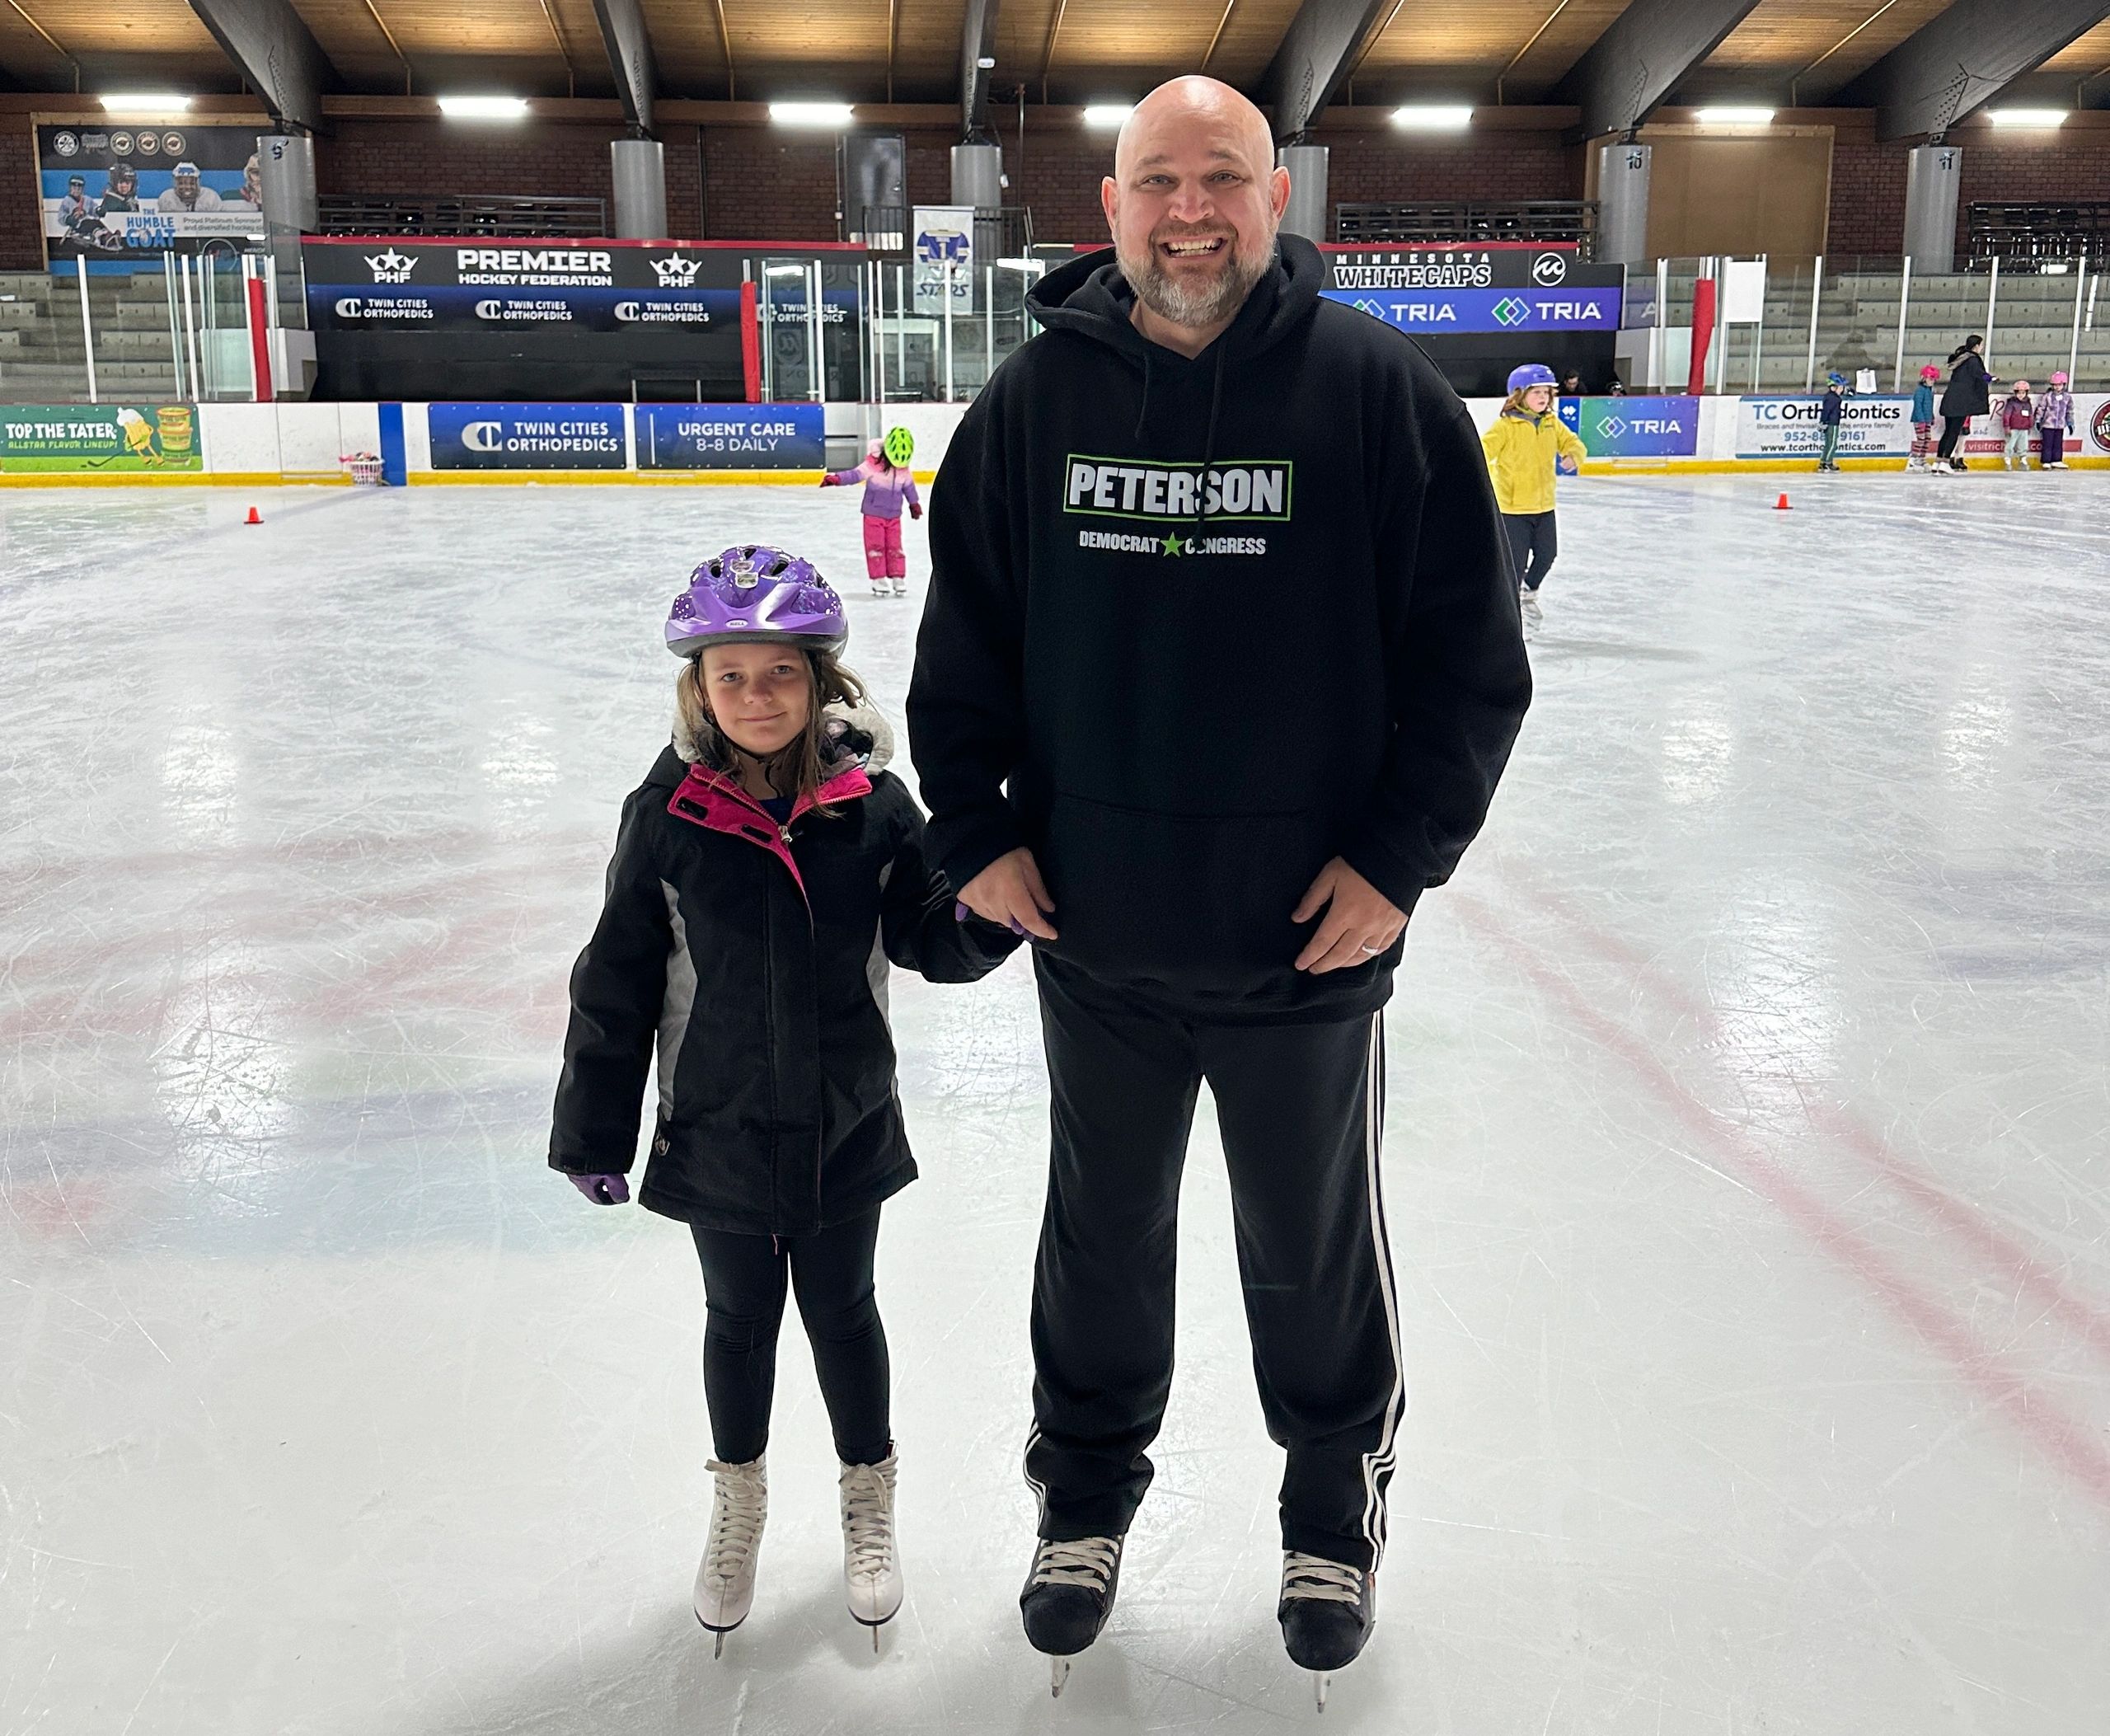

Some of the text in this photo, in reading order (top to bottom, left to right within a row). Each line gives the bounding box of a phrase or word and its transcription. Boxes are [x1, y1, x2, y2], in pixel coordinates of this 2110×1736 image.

[127, 217, 175, 228] HUMBLE
[126, 228, 176, 248] GOAT
[457, 249, 612, 273] PREMIER
[1336, 252, 1490, 265] MINNESOTA
[373, 271, 411, 284] PHF
[458, 273, 613, 286] HOCKEY FEDERATION
[659, 275, 694, 288] PHF
[1334, 264, 1492, 289] WHITECAPS
[368, 298, 428, 309] TWIN CITIES
[507, 300, 566, 311] TWIN CITIES
[645, 302, 704, 312] TWIN CITIES
[782, 303, 807, 312] TWIN
[363, 308, 434, 320] ORTHOPEDICS
[503, 310, 572, 321] ORTHOPEDICS
[641, 312, 710, 323] ORTHOPEDICS
[1390, 303, 1456, 321] TRIA
[1535, 302, 1601, 320] TRIA
[1752, 402, 1901, 420] TC Orthdontics
[5, 423, 117, 439] TOP THE TATER
[514, 422, 608, 436] TWIN CITIES
[678, 423, 795, 437] URGENT CARE
[1629, 420, 1681, 434] TRIA
[1873, 422, 1895, 430] family
[7, 440, 118, 449] ALLSTAR FLAVOR LINEUP!
[506, 437, 617, 452] ORTHOPEDICS
[696, 438, 778, 452] 8-8 DAILY
[1761, 442, 1886, 453] www.tcorthontics.com
[1069, 462, 1283, 514] PETERSON
[1079, 530, 1160, 553] DEMOCRAT
